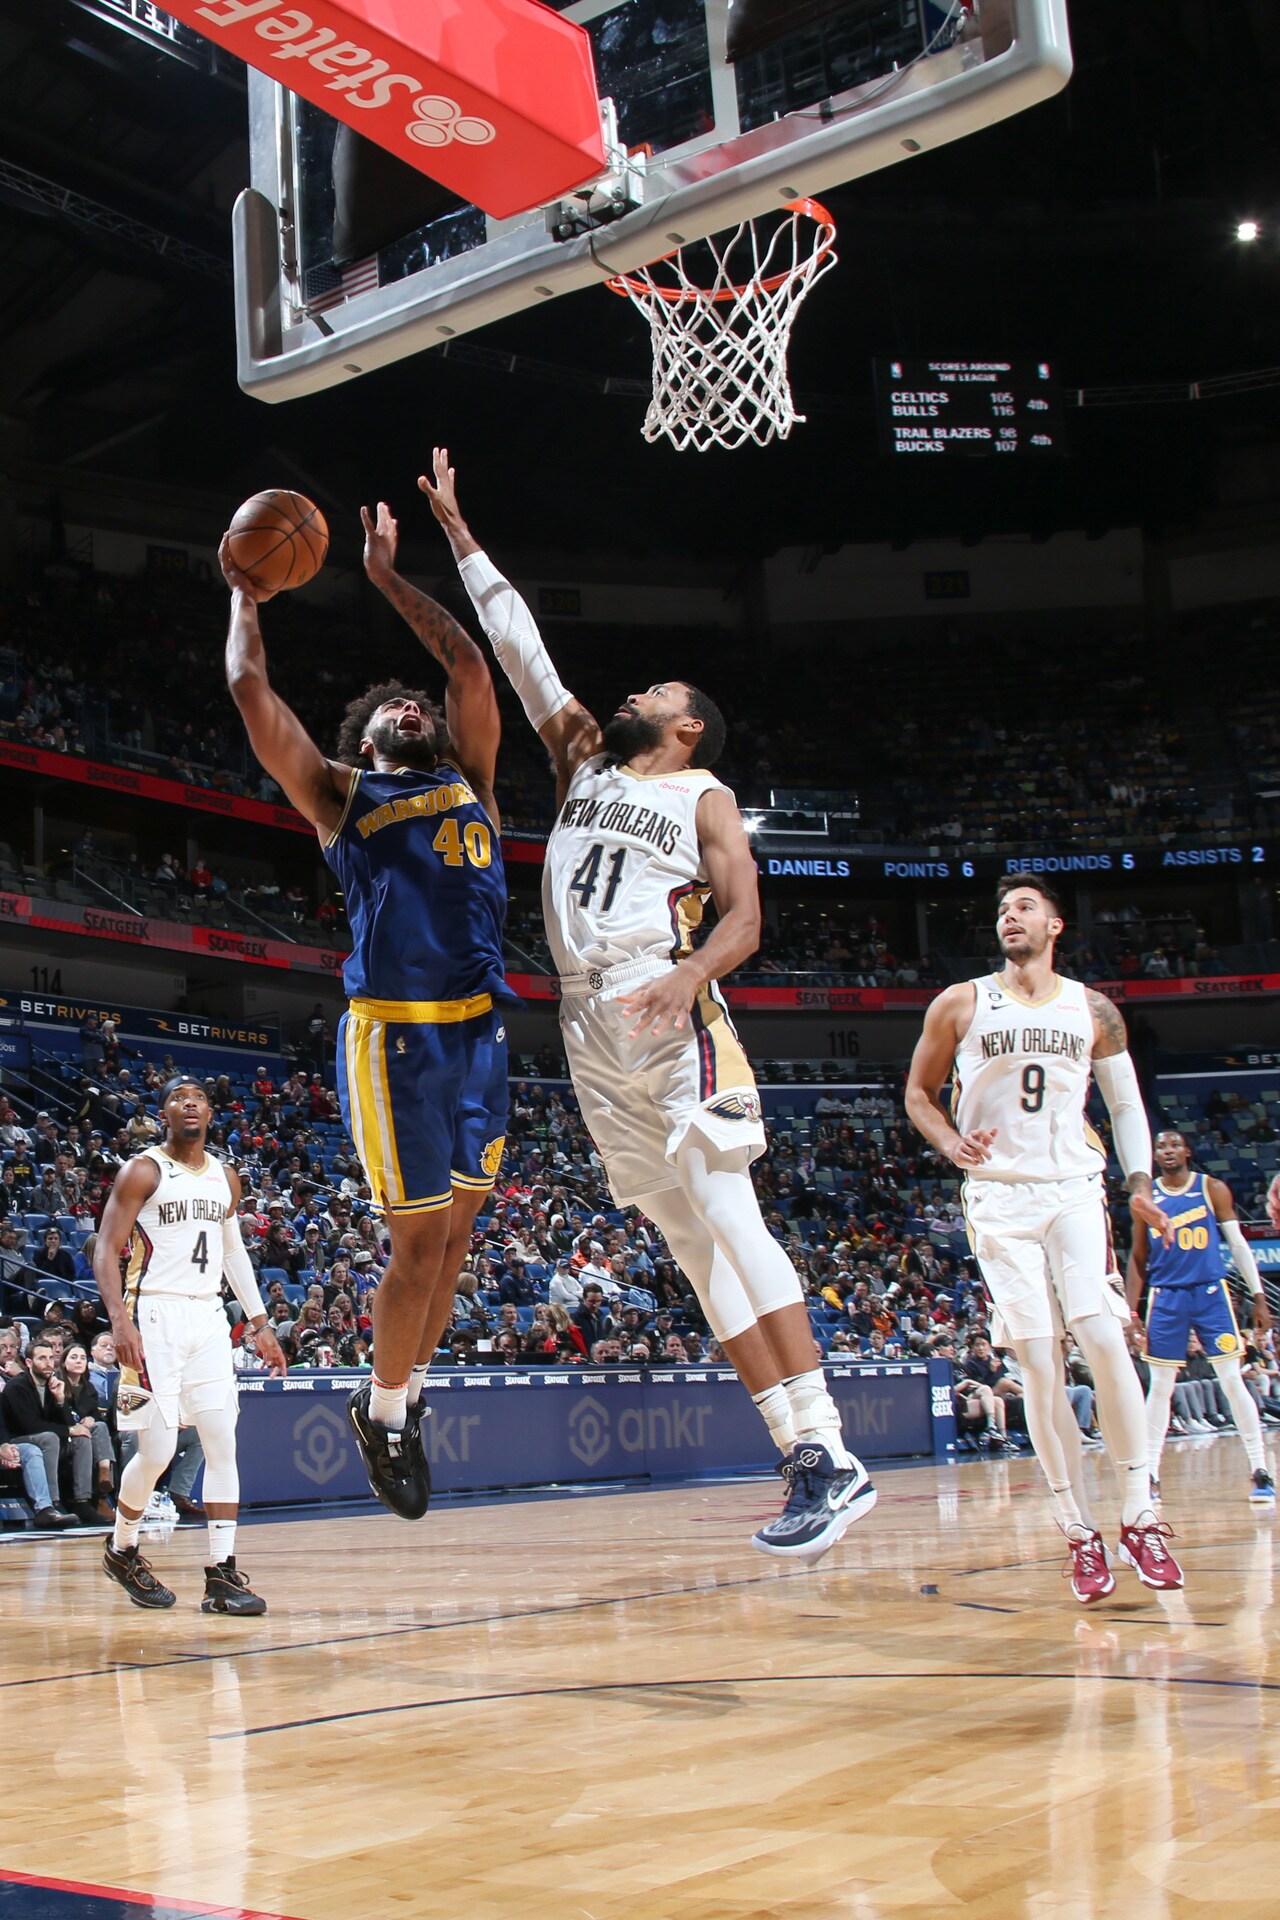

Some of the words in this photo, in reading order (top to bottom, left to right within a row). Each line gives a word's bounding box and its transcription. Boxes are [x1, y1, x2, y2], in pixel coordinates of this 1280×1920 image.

[928, 363, 968, 371] SCORES
[970, 363, 1011, 371] AROUND
[938, 373, 957, 382] THE
[958, 374, 998, 382] LEAGUE
[891, 392, 949, 403] CELTICS
[1026, 399, 1049, 410] 4th
[892, 405, 939, 416] BULLS
[992, 405, 1015, 416] 116
[893, 427, 931, 438] TRAIL
[933, 427, 992, 439] BLAZERS
[1030, 434, 1052, 445] 4th
[895, 440, 945, 451] BUCKS
[994, 441, 1018, 451] 107
[659, 781, 690, 794] ibotta
[560, 798, 605, 830] NEW
[600, 801, 682, 855] ORLEANS
[432, 818, 492, 869] 40
[1006, 854, 1112, 874] REBOUNDS
[1122, 853, 1135, 869] 5
[1163, 848, 1242, 866] ASSISTS
[1251, 846, 1265, 862] 2
[568, 843, 628, 913] 41
[768, 859, 850, 877] DANIELS
[884, 862, 949, 877] POINTS
[962, 861, 974, 877] 6
[83, 910, 149, 940] SEATGEEK
[208, 934, 268, 961] SEATGEEK
[31, 966, 63, 996] 114
[1194, 979, 1265, 995] SEATGEEK
[796, 990, 864, 1007] SEATGEEK
[178, 1022, 268, 1045] BETRIVERS
[827, 1030, 860, 1057] 116
[981, 1028, 1017, 1059] NEW
[1022, 1028, 1084, 1061] ORLEANS
[1021, 1064, 1046, 1113] 9
[158, 1200, 188, 1227] NEW
[1177, 1226, 1209, 1251] 00
[191, 1230, 209, 1274] 4
[236, 1381, 265, 1392] EATGEEK
[282, 1380, 314, 1391] SEATGEEK
[463, 1376, 491, 1387] SEATGEEK
[504, 1376, 530, 1386] SEATGEEK
[544, 1375, 569, 1385] SEATGEEK
[931, 1385, 951, 1402] SEAT
[837, 1391, 895, 1437] nkr
[931, 1401, 954, 1417] GEEK
[420, 1408, 481, 1463] kr
[617, 1399, 713, 1453] ankr
